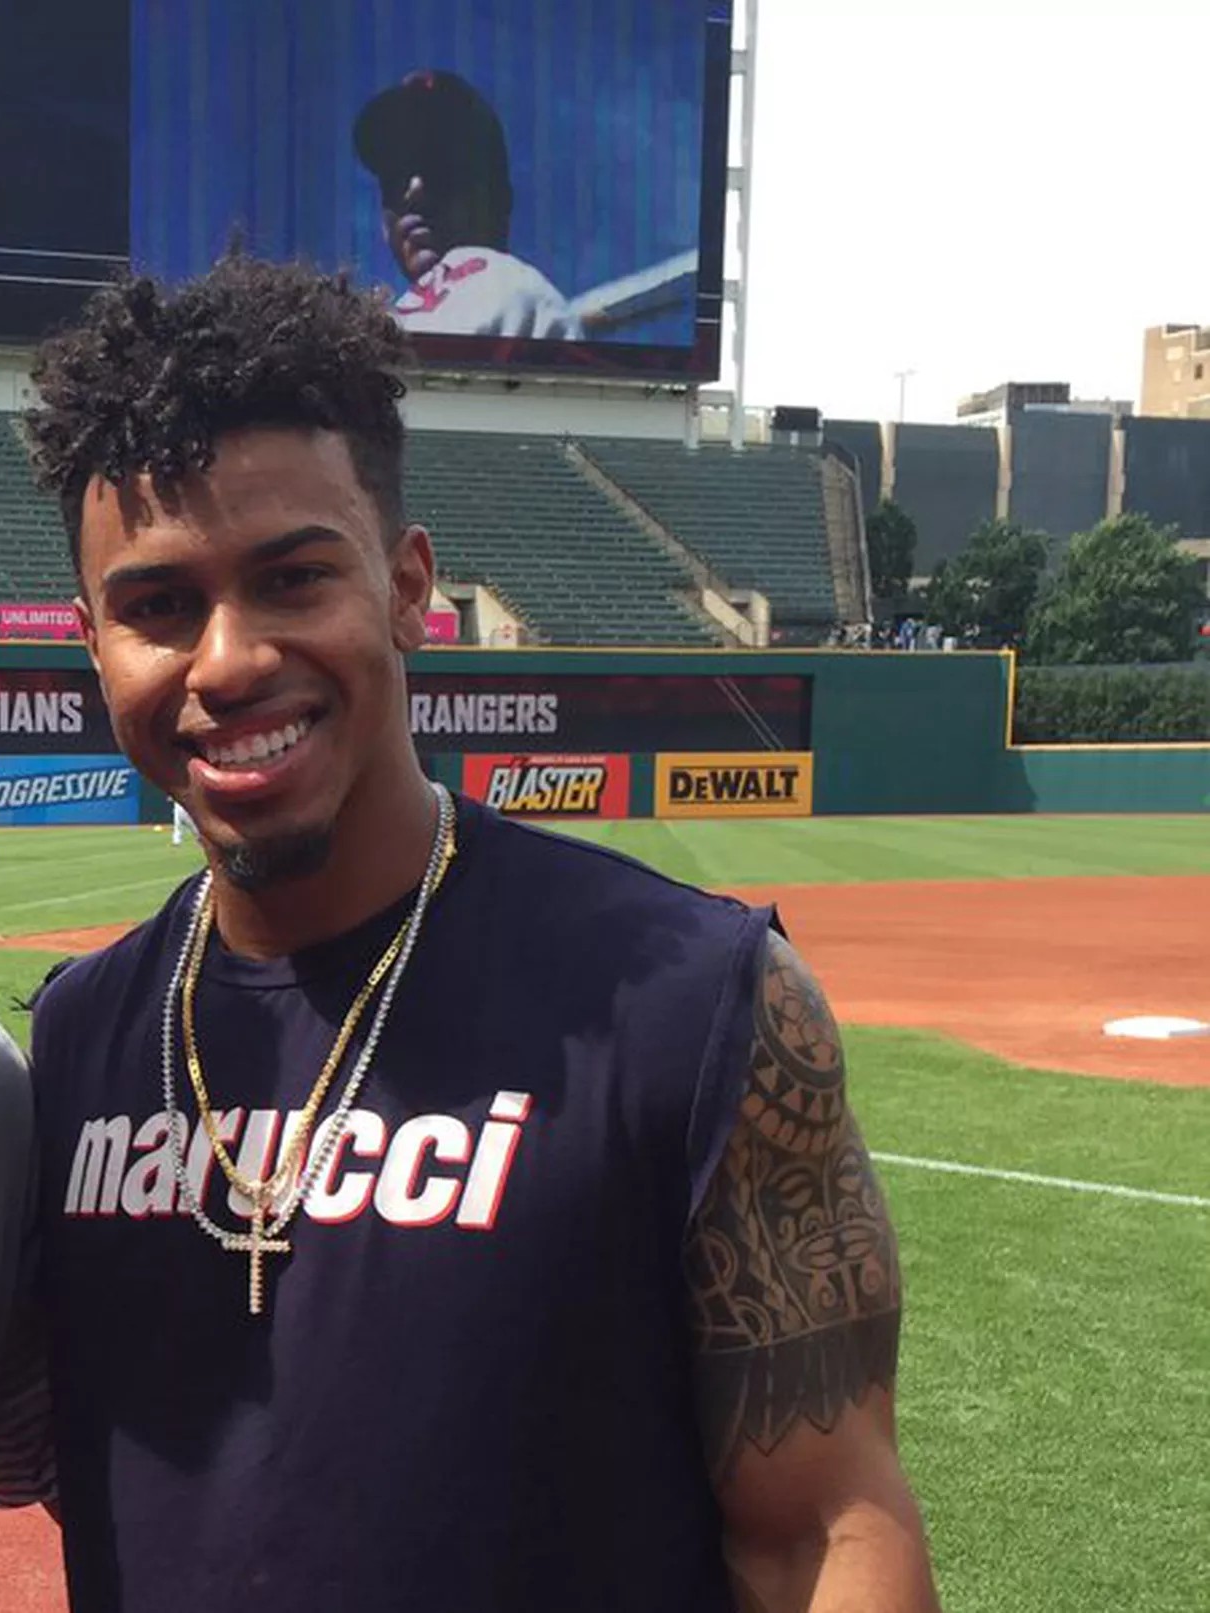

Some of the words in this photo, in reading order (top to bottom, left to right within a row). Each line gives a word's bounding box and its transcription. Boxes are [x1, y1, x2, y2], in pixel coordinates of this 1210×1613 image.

[1, 611, 76, 625] UNLIMITED
[410, 693, 558, 733] RANGERS
[486, 765, 605, 811] BLASTER
[64, 1090, 533, 1231] marucci
